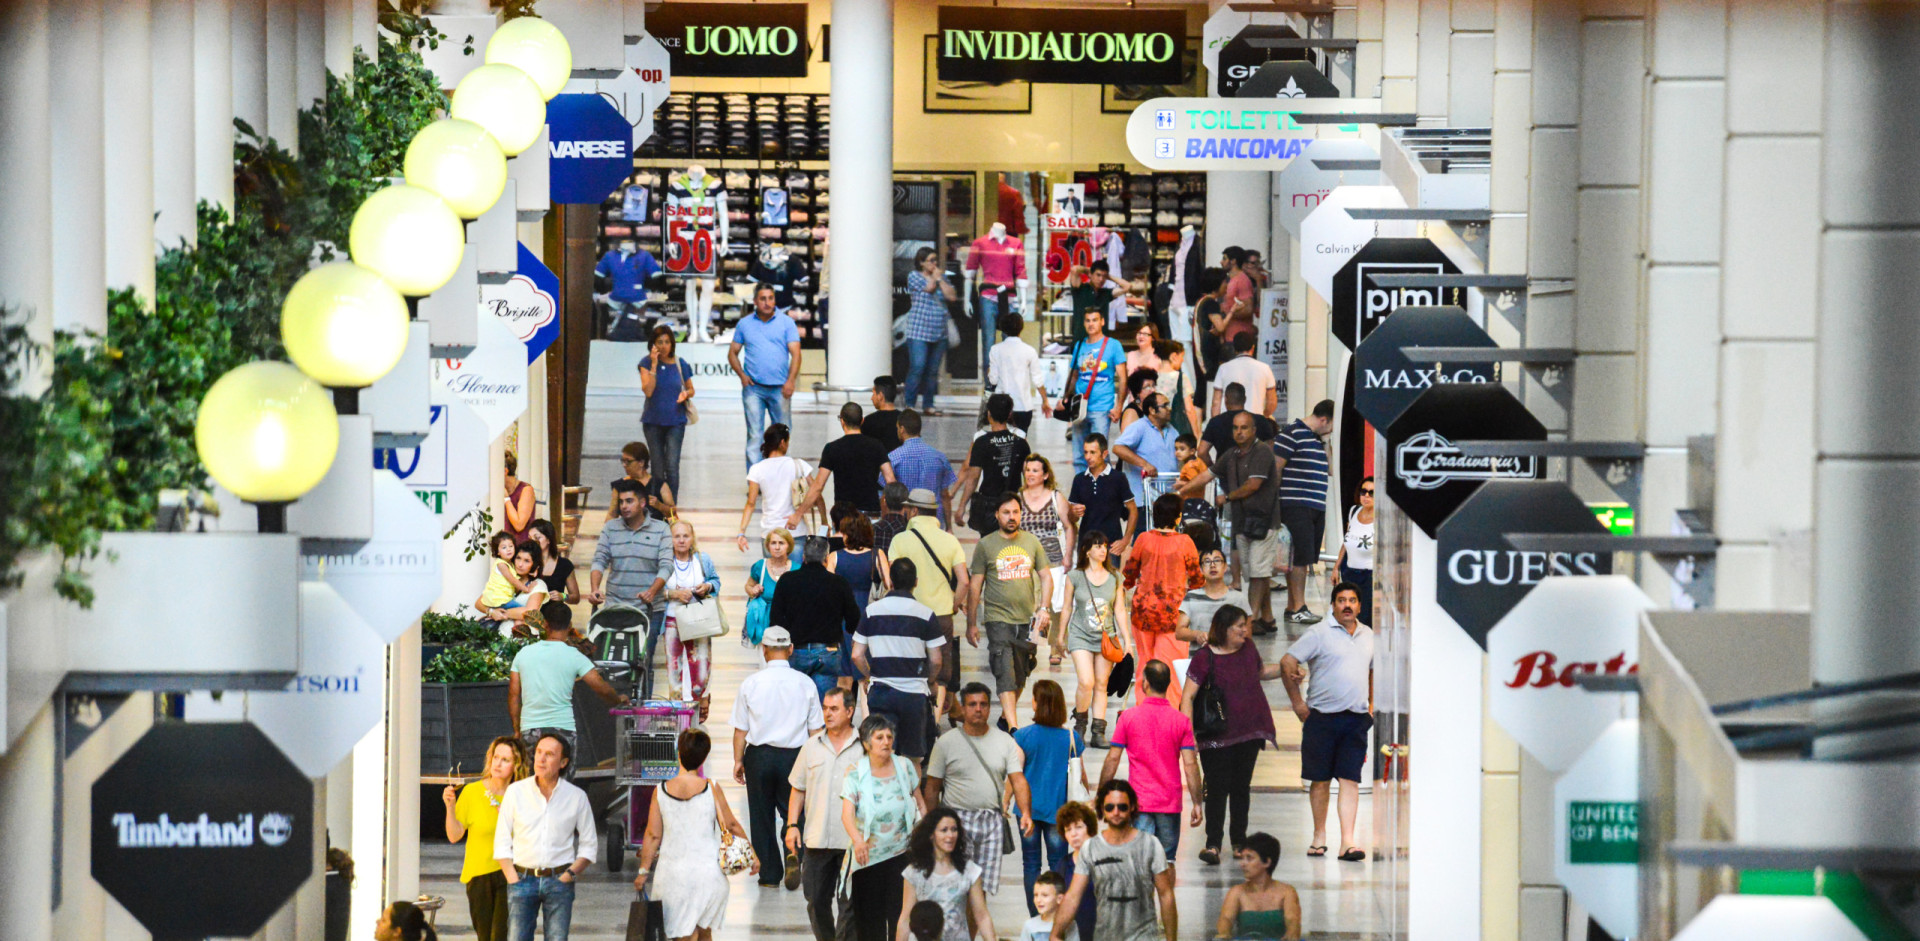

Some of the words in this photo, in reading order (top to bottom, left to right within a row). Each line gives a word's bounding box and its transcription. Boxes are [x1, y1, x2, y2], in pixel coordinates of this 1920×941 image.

[685, 26, 798, 56] UOMO
[944, 29, 1175, 63] INVIDIAUOMO
[1185, 109, 1304, 130] TOILETTE
[666, 205, 714, 217] SALDI
[1047, 216, 1094, 229] SALDI
[665, 220, 713, 273] 50
[1316, 243, 1350, 254] Calvin
[1448, 549, 1597, 586] GUESS
[112, 812, 254, 848] Timberland
